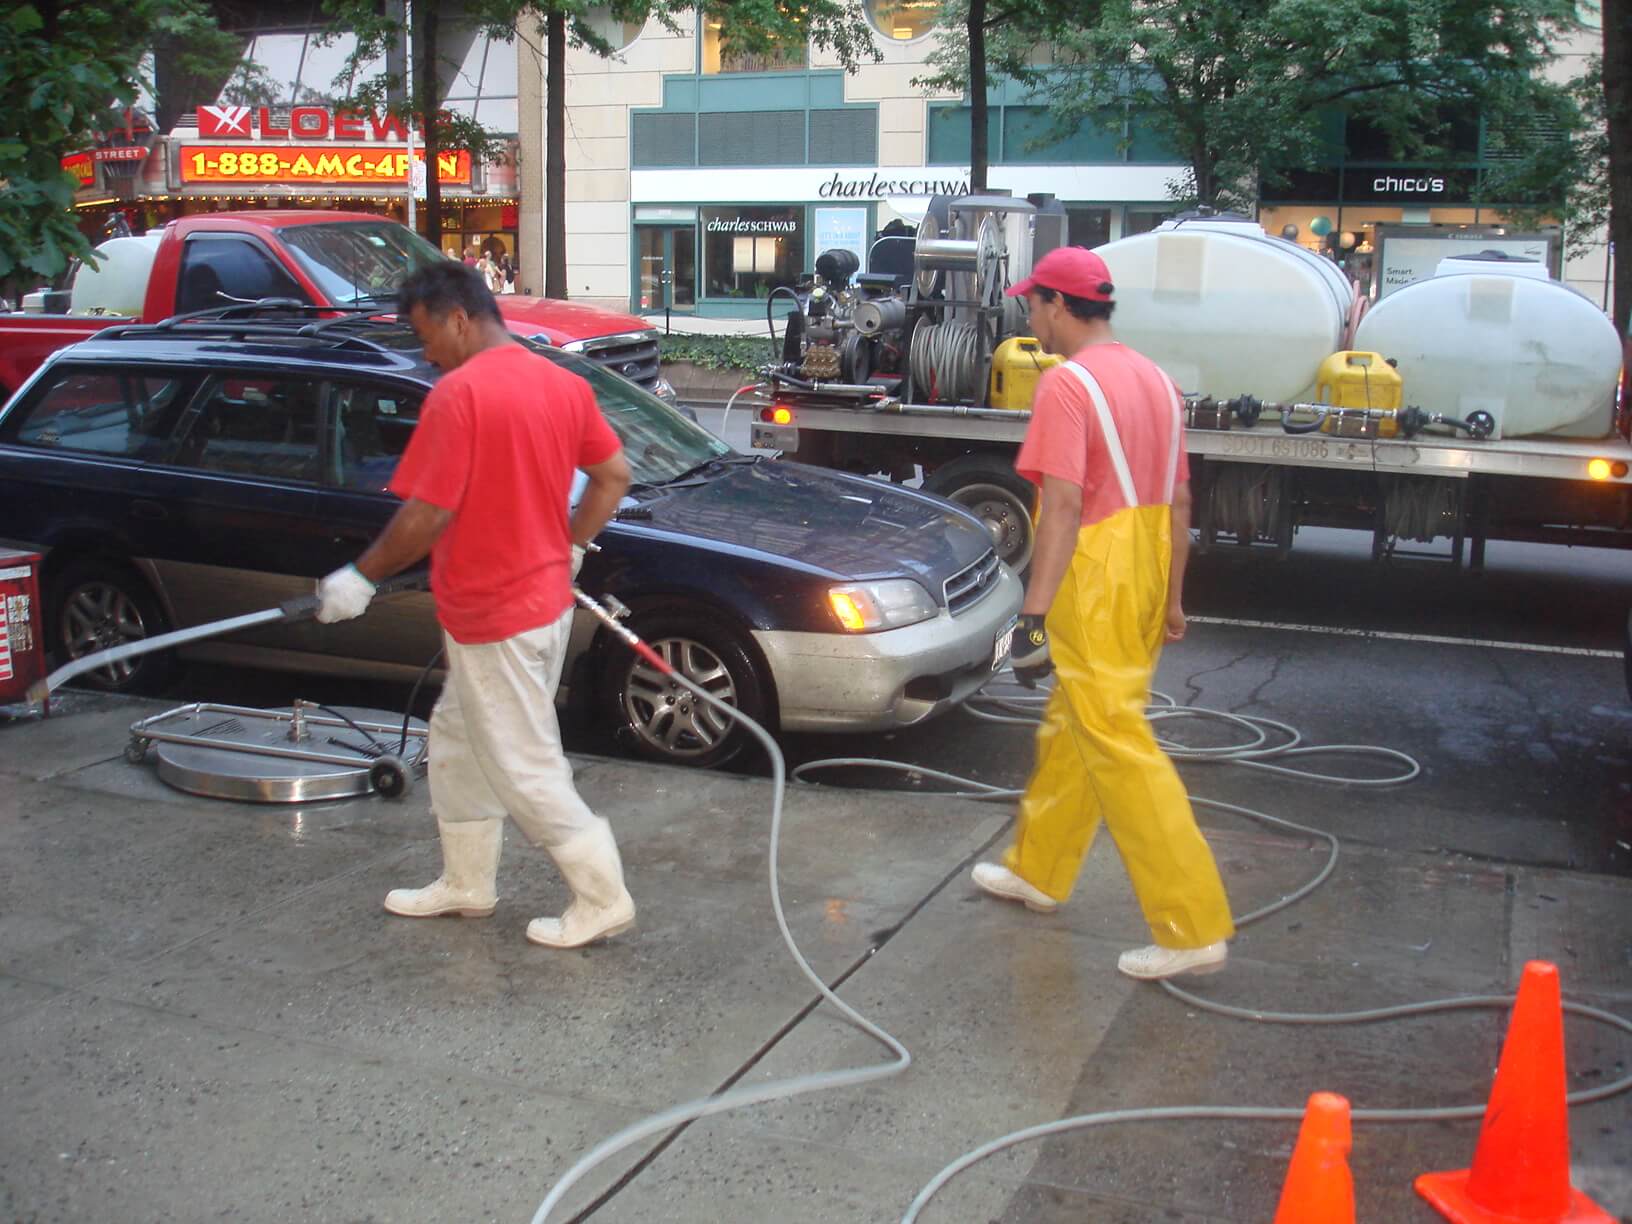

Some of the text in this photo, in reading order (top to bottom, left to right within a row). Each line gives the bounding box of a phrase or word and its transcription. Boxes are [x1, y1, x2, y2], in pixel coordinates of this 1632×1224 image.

[95, 149, 139, 159] STREET
[192, 152, 458, 177] 1-888-AMC-4FN
[899, 180, 971, 195] SCHWA
[1373, 176, 1444, 192] chico's
[707, 217, 796, 232] charles SCHWAB
[1386, 267, 1413, 276] Smart
